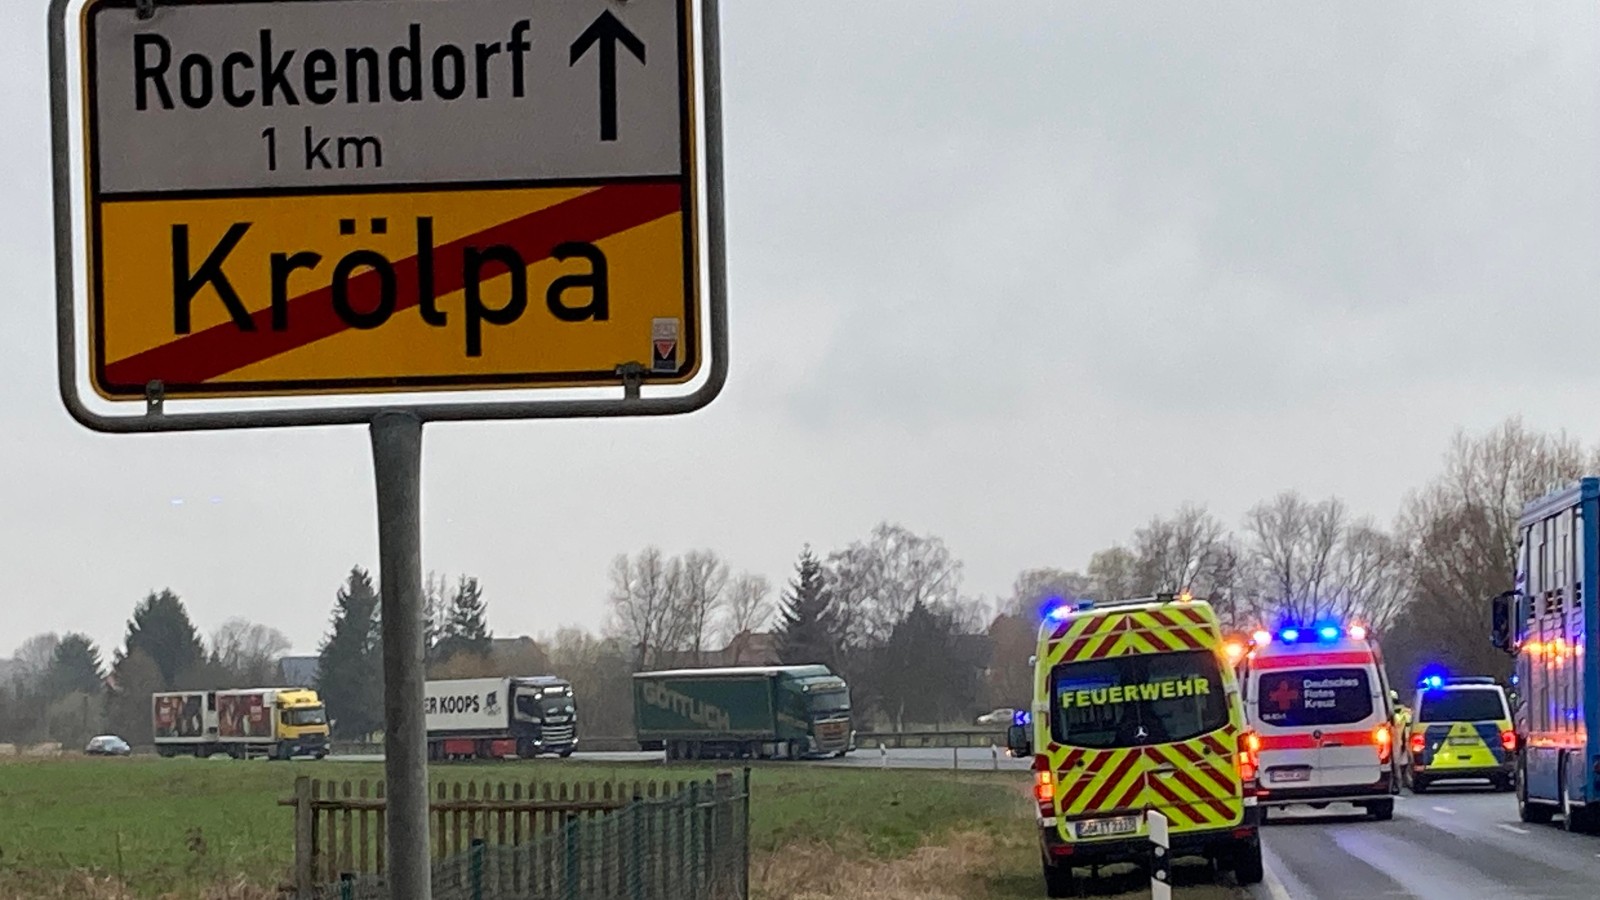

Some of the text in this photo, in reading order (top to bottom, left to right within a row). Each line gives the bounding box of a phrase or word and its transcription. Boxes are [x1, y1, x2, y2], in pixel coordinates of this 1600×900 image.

[133, 19, 532, 111] Rockendorf
[261, 126, 383, 171] 1 km
[171, 216, 610, 357] Krölpa
[1061, 678, 1210, 709] FEUERWEHR
[1303, 677, 1360, 689] Deutsches
[1304, 689, 1336, 699] Rotes
[440, 695, 480, 715] KOOPS
[1304, 699, 1337, 709] Kreuz
